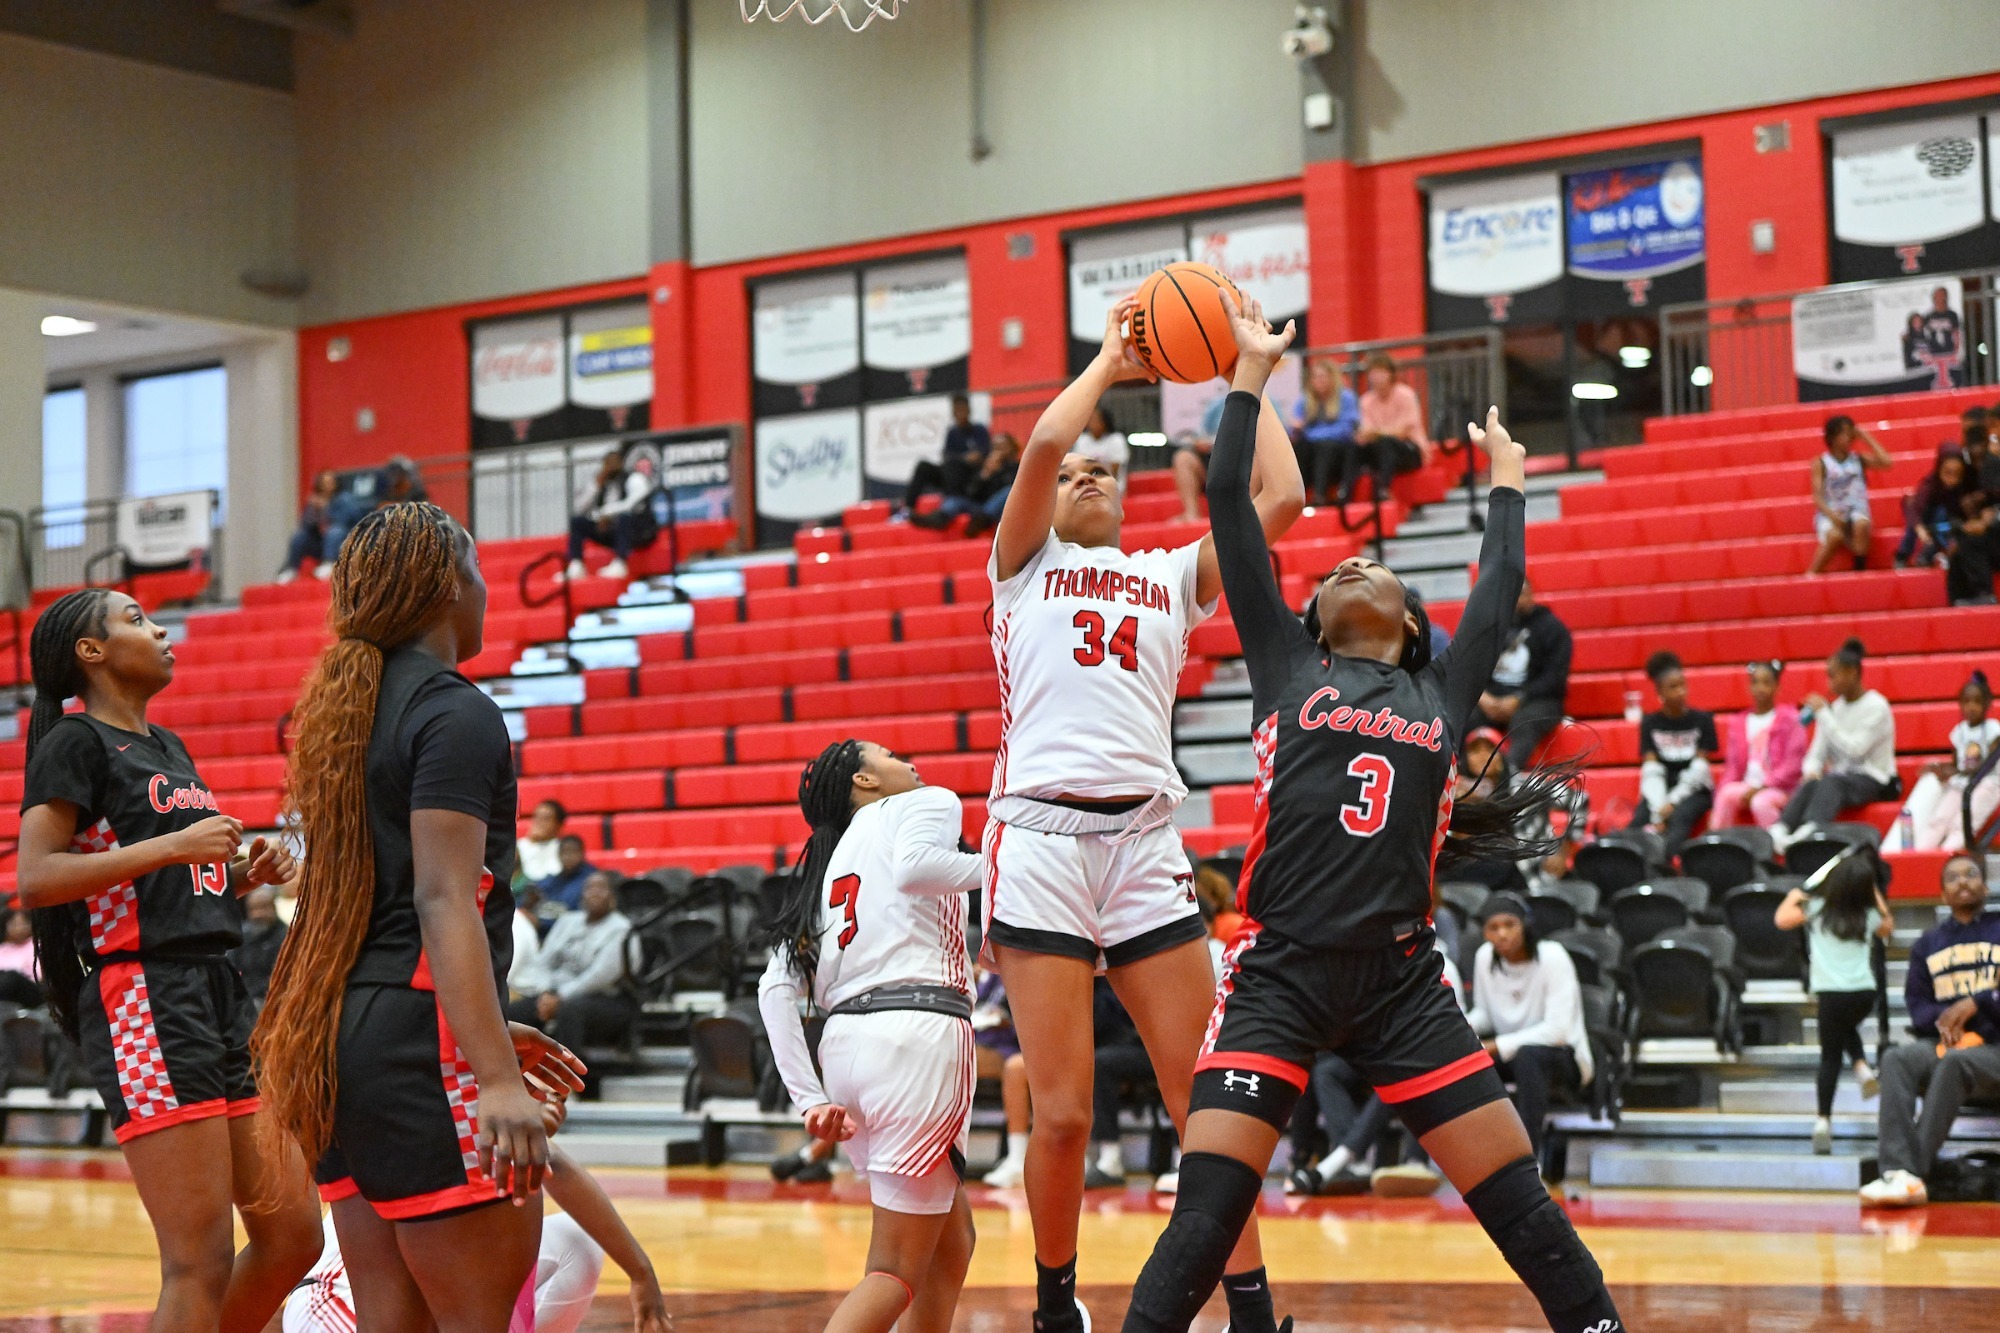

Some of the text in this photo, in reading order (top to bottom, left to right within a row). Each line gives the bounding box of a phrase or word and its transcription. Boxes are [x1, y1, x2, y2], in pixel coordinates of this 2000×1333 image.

[1441, 205, 1557, 243] Encore
[765, 437, 844, 489] Shelby
[1043, 566, 1171, 616] THOMPSON
[1073, 609, 1139, 673] 34
[1298, 685, 1443, 752] Central
[148, 773, 220, 814] Centra
[1338, 752, 1396, 838] 3
[829, 872, 862, 951] 3
